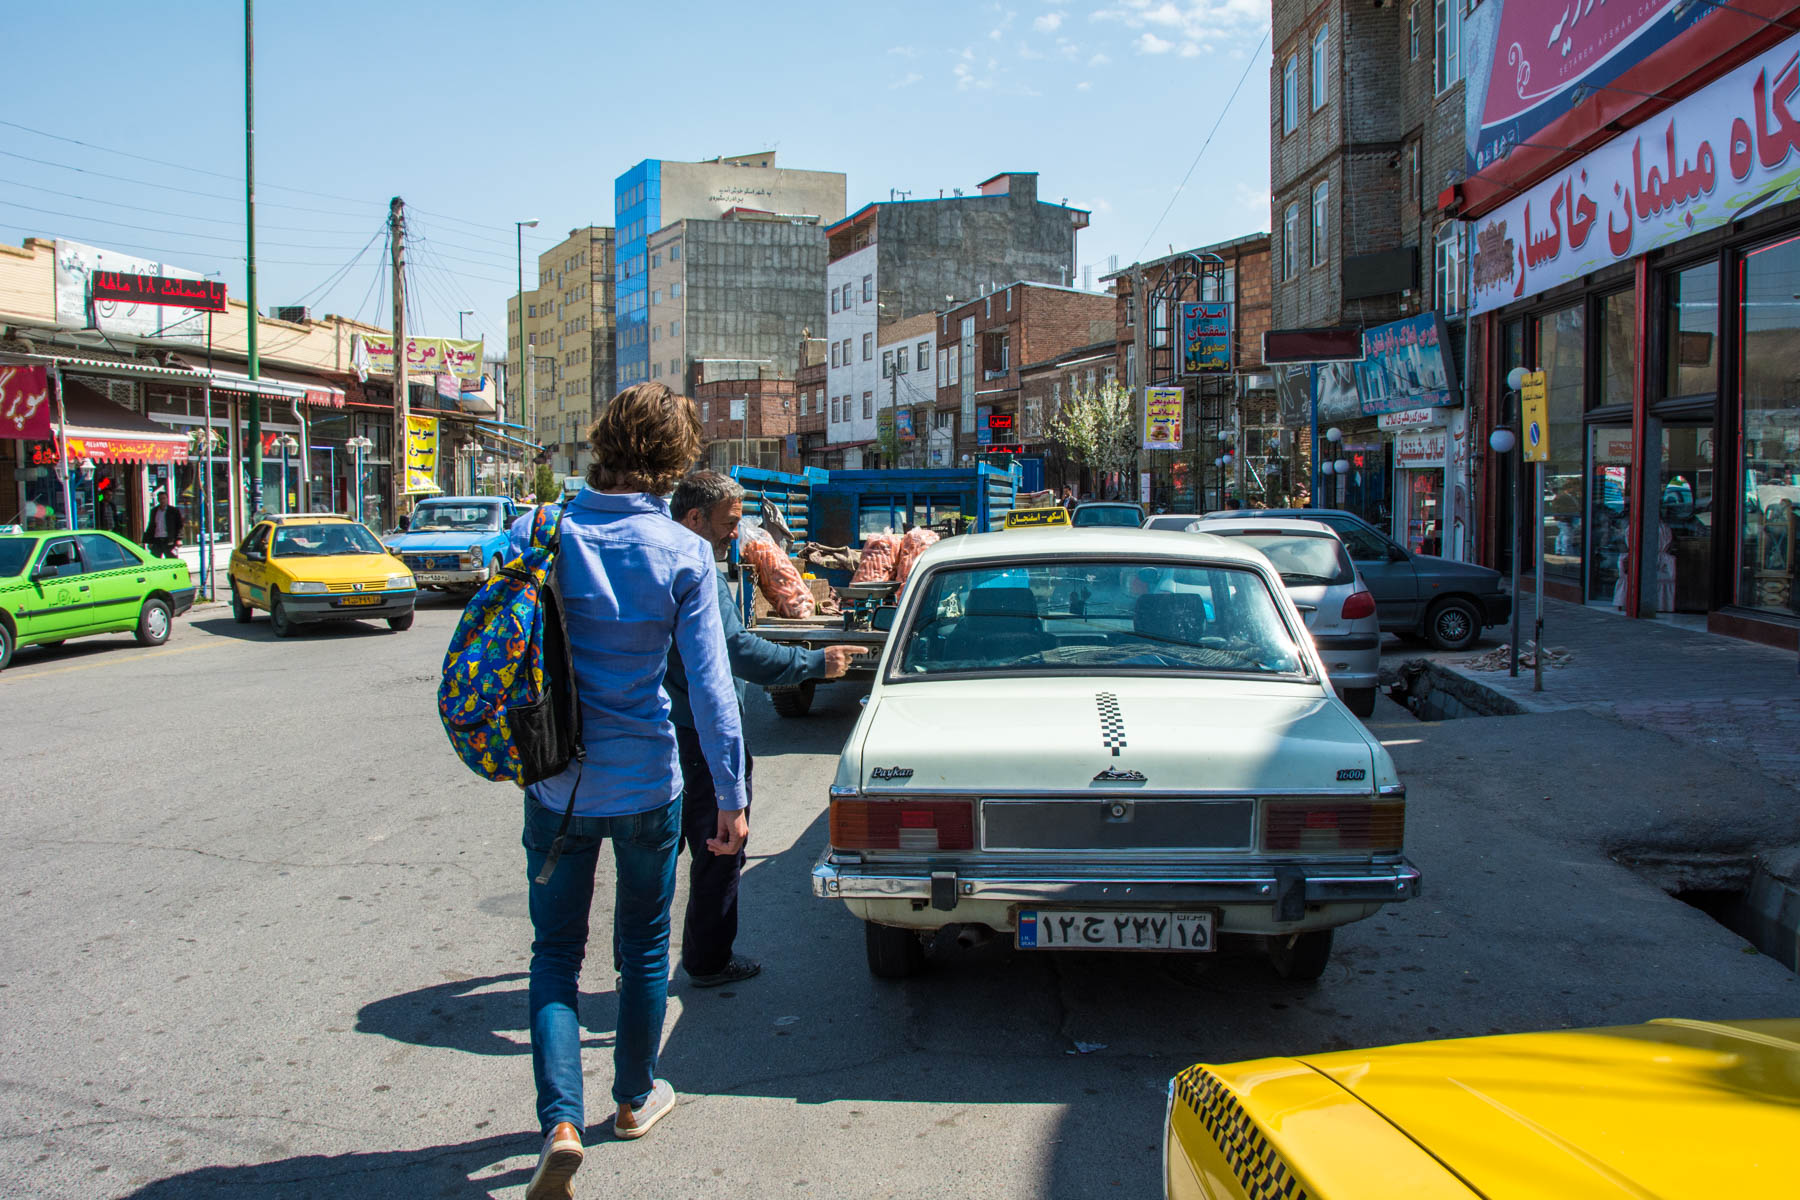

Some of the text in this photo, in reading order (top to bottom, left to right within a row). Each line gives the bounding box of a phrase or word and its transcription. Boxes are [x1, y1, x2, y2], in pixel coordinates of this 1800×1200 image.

[1608, 117, 1716, 257] مبلمان
[1513, 168, 1598, 298] خاکسار
[137, 274, 155, 293] ۱۸
[161, 278, 206, 299] ضمانت
[210, 280, 221, 305] با
[1186, 306, 1227, 319] املاک
[1187, 325, 1227, 341] شفقتیان
[407, 338, 436, 363] مرغ
[1188, 341, 1227, 355] صدور کد
[1186, 357, 1229, 371] رهگیری
[7, 390, 46, 429] سوپر
[1148, 407, 1174, 417] فلافل
[1425, 437, 1446, 461] املاک
[1010, 513, 1040, 525] اسفنجان
[872, 766, 914, 781] Paykan
[1043, 916, 1167, 944] ۱۲ ج ۲۲۷
[1177, 923, 1208, 947] ۱۵
